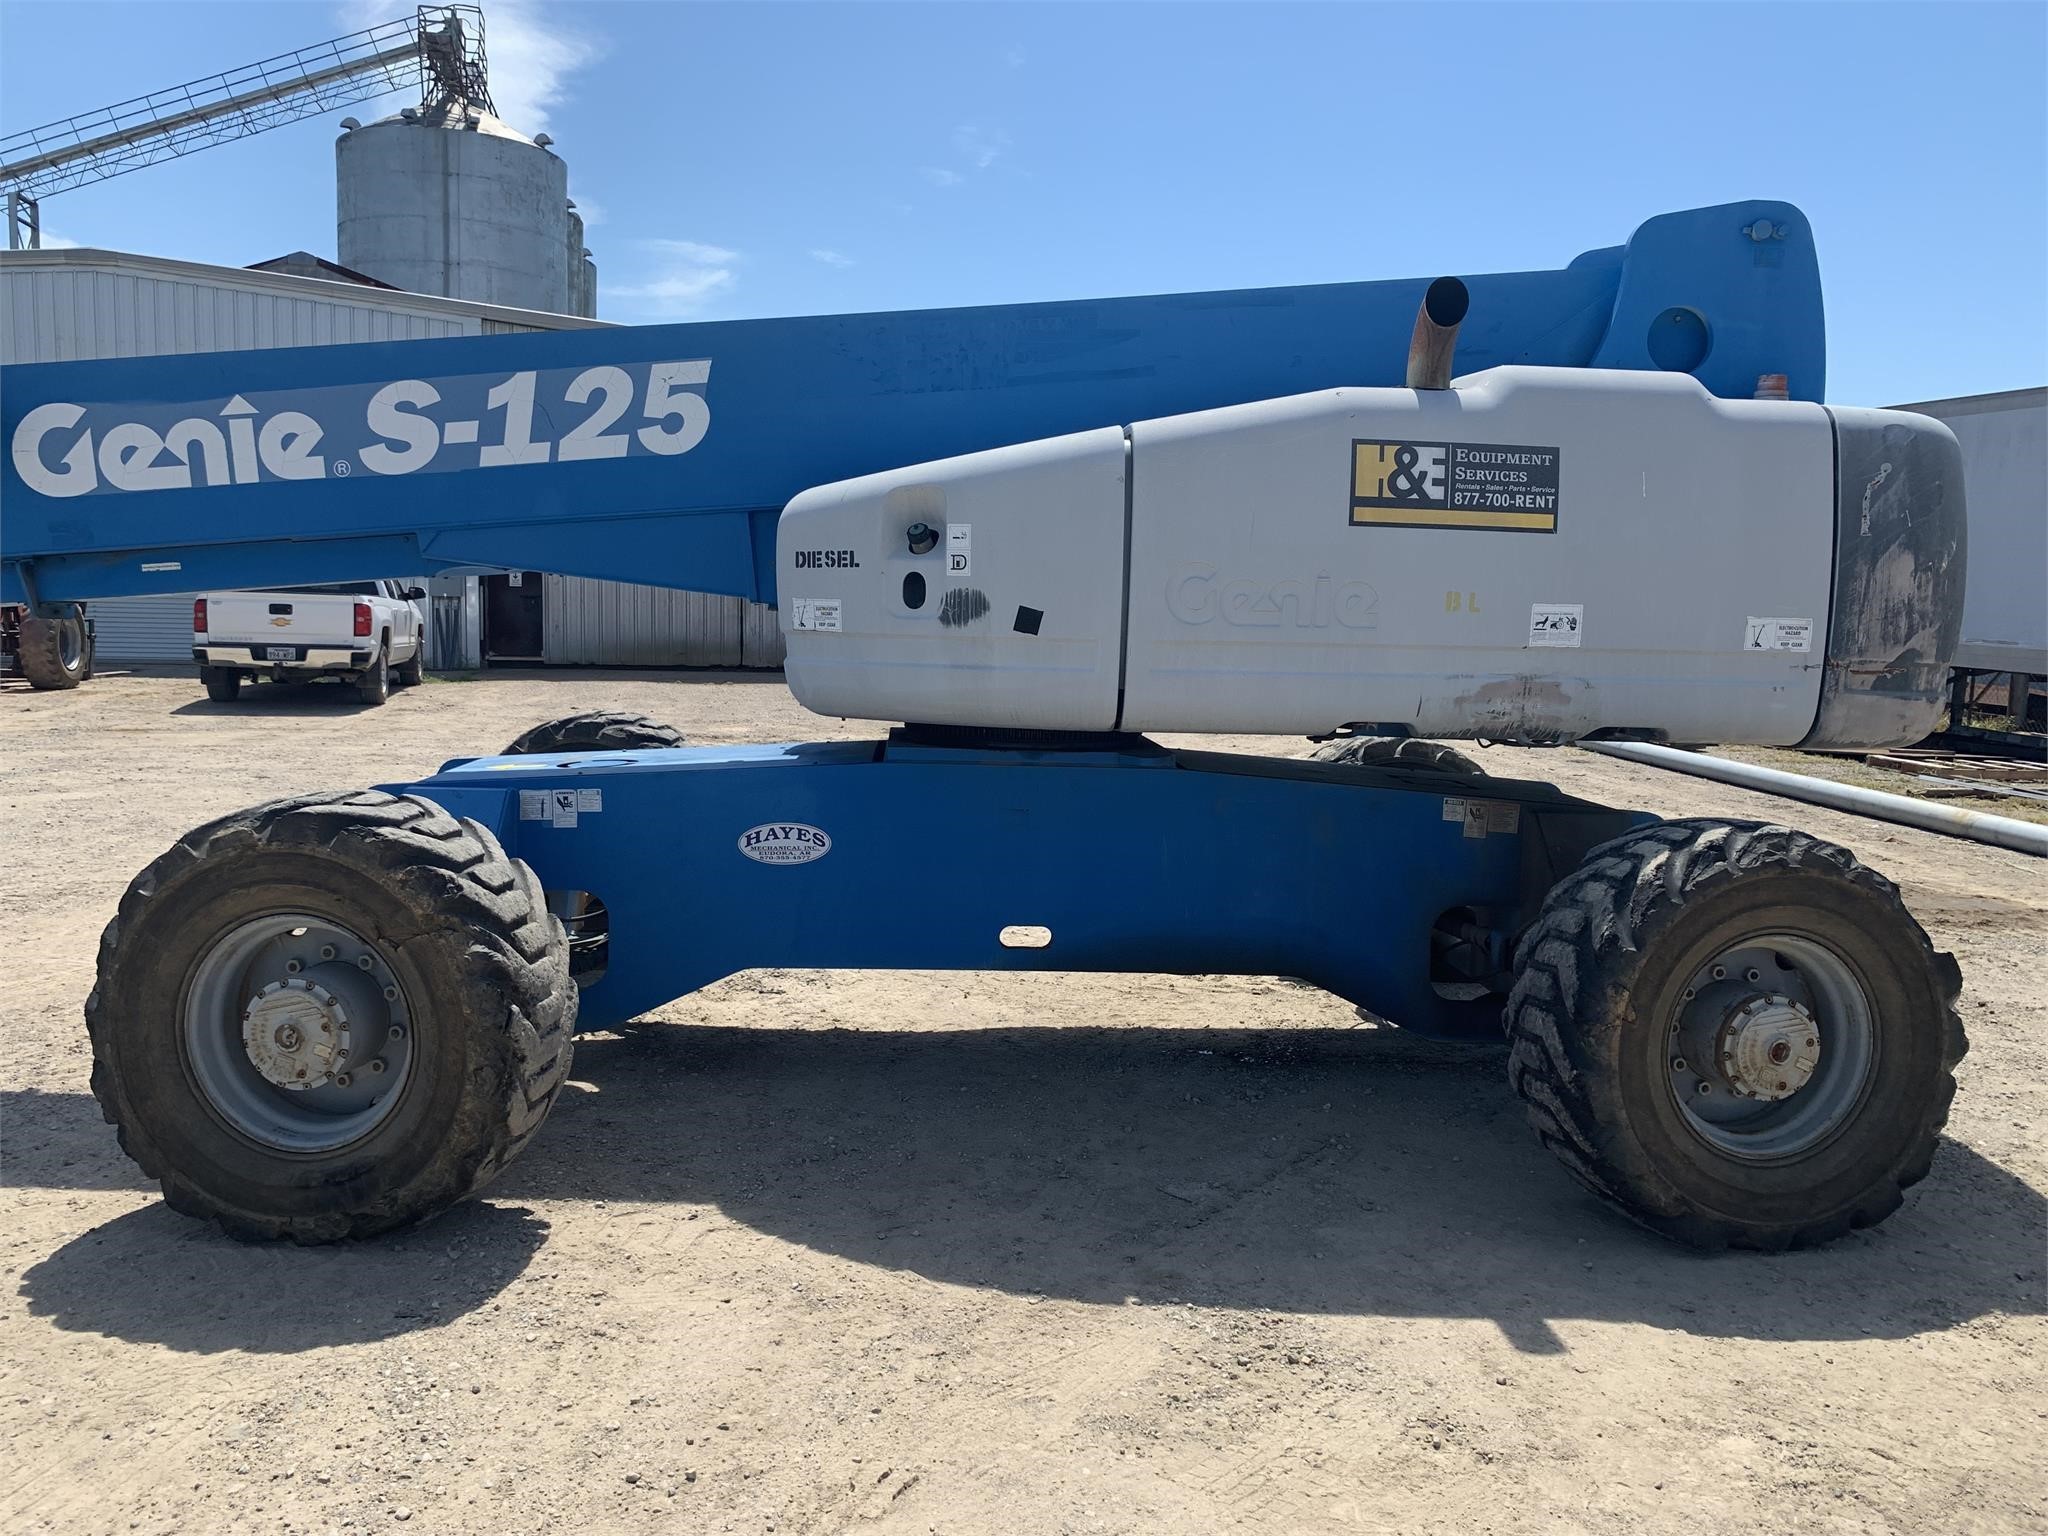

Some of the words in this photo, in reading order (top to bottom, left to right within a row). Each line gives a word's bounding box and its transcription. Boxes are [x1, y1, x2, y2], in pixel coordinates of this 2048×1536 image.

[12, 394, 327, 497] Genie
[358, 360, 712, 475] S-125
[1455, 448, 1553, 466] EQUIPMENT
[1355, 444, 1446, 500] H&E
[1455, 466, 1528, 482] SERVICES
[1455, 482, 1480, 490] Rentals
[1531, 486, 1556, 494] Service
[1454, 491, 1556, 508] 877-700-RENT
[795, 550, 860, 568] DIESEL
[1164, 560, 1379, 629] Genie
[744, 826, 826, 848] HAYES
